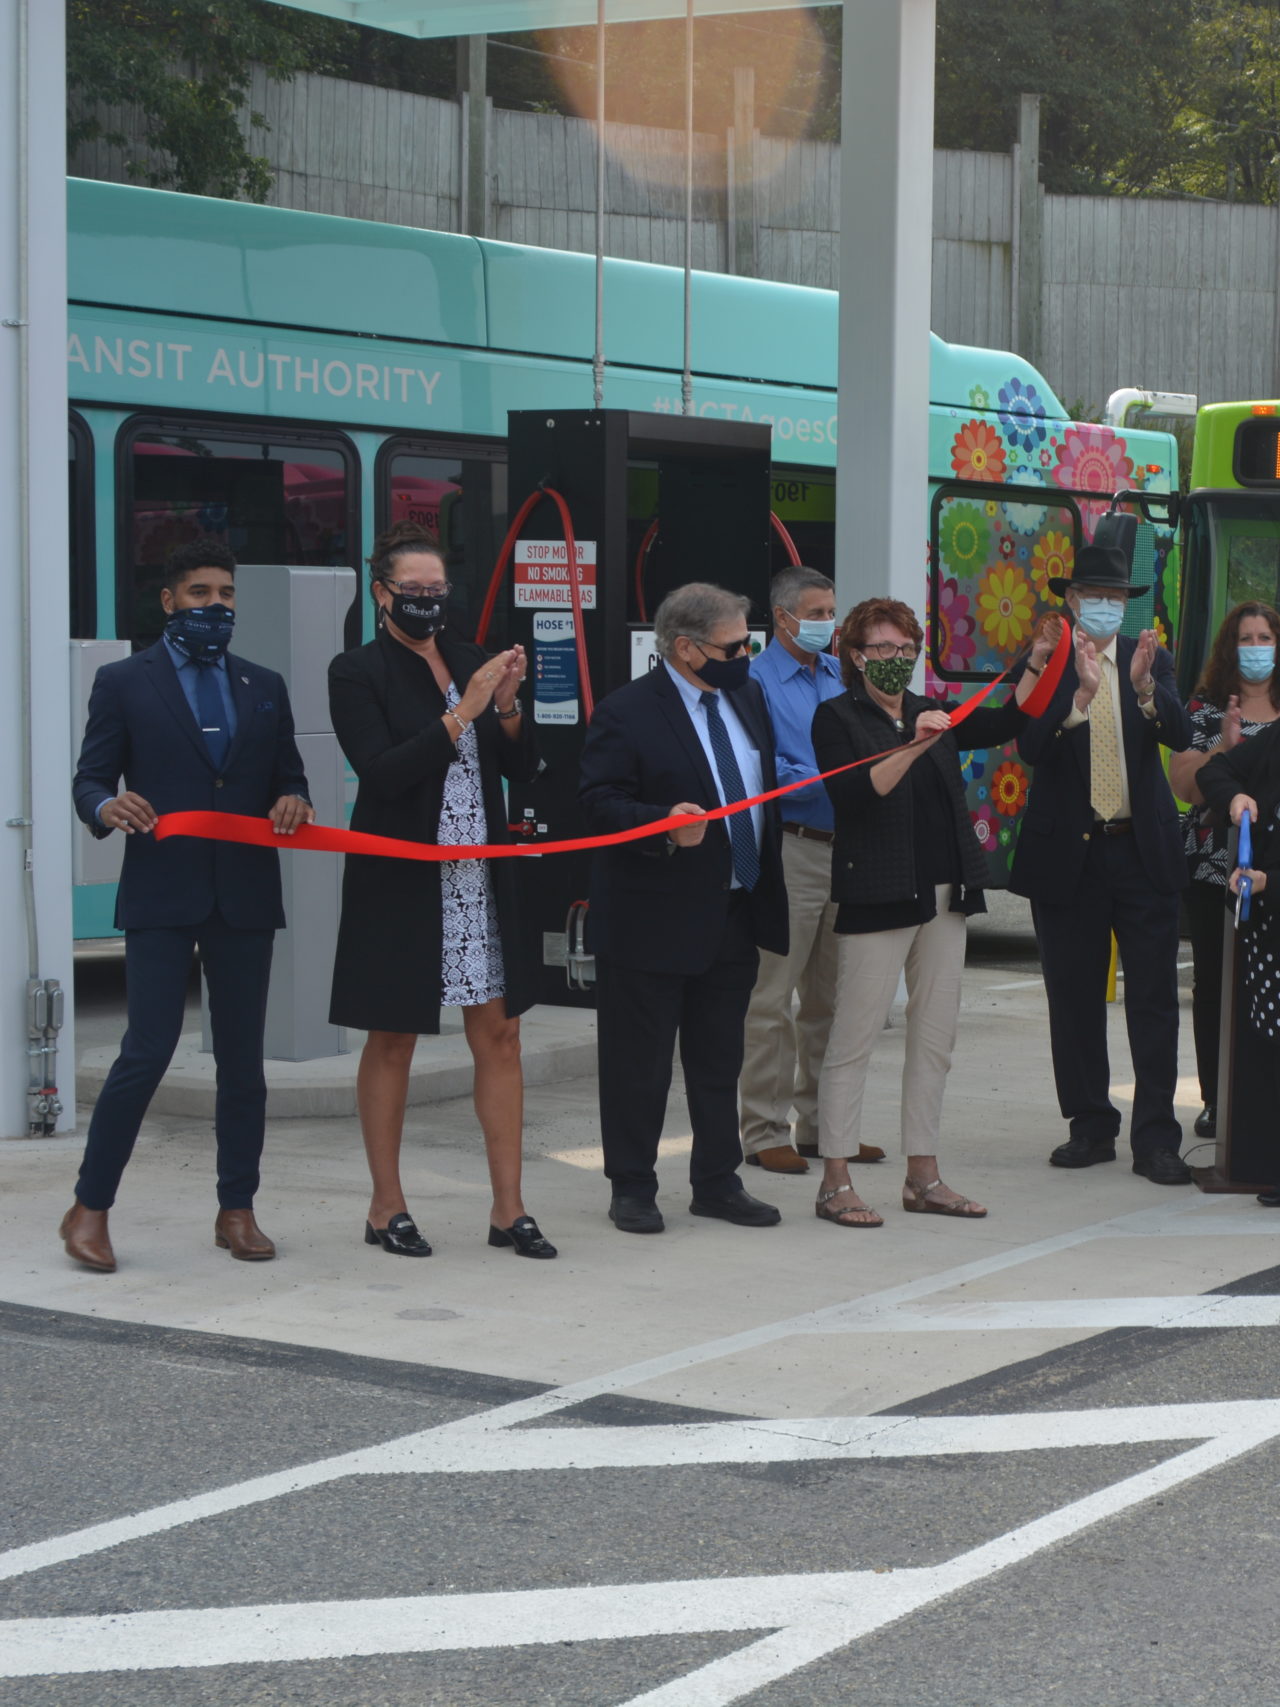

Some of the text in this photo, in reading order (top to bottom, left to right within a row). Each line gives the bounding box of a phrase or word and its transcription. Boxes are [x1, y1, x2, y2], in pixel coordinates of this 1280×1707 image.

[206, 348, 441, 405] AUTHORITY
[527, 545, 584, 559] STOP MOR
[527, 566, 583, 582] NO SMOKG
[536, 620, 564, 630] HOSE
